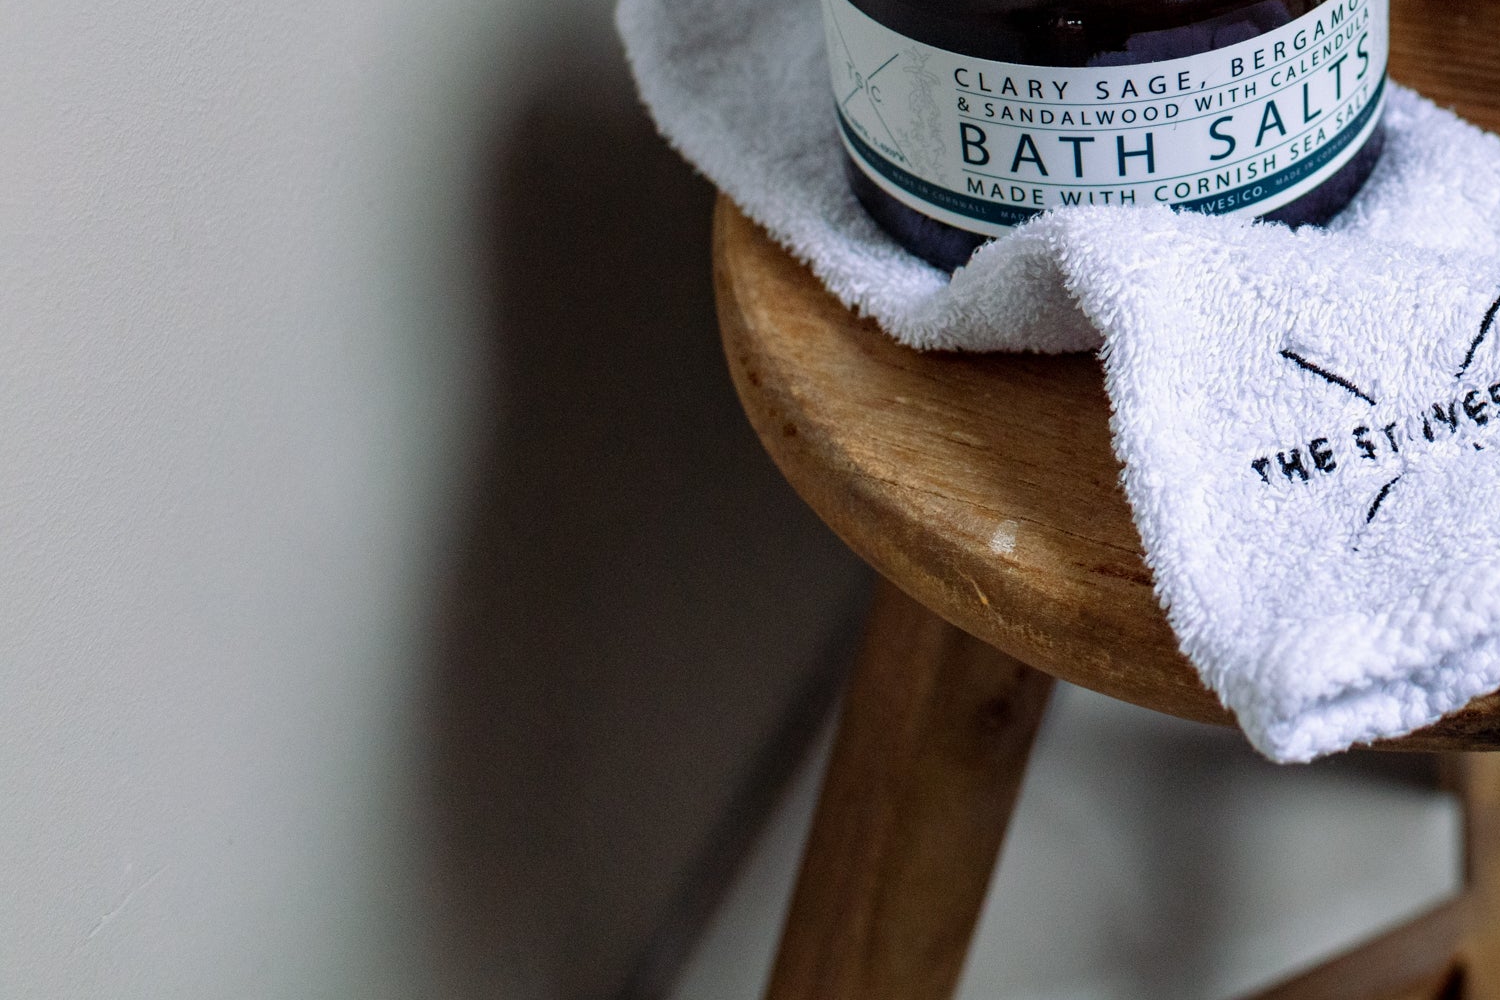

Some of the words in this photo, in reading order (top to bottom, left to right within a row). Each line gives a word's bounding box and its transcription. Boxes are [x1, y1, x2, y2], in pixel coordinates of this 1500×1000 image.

[954, 68, 1068, 100] CLARY
[1096, 71, 1206, 100] SAGE,
[958, 96, 970, 113] &
[985, 102, 1180, 126] SANDALWOOD
[1195, 81, 1257, 112] WITH
[1271, 7, 1370, 88] CALENDULA
[959, 121, 1156, 179] BATH
[1209, 31, 1370, 162] SALTS
[966, 177, 1045, 206] MADE
[1060, 189, 1136, 206] WITH
[1154, 154, 1277, 202] CORNISH
[1289, 127, 1326, 161] SEA
[1335, 83, 1369, 130] SALT
[1251, 437, 1338, 485] THE
